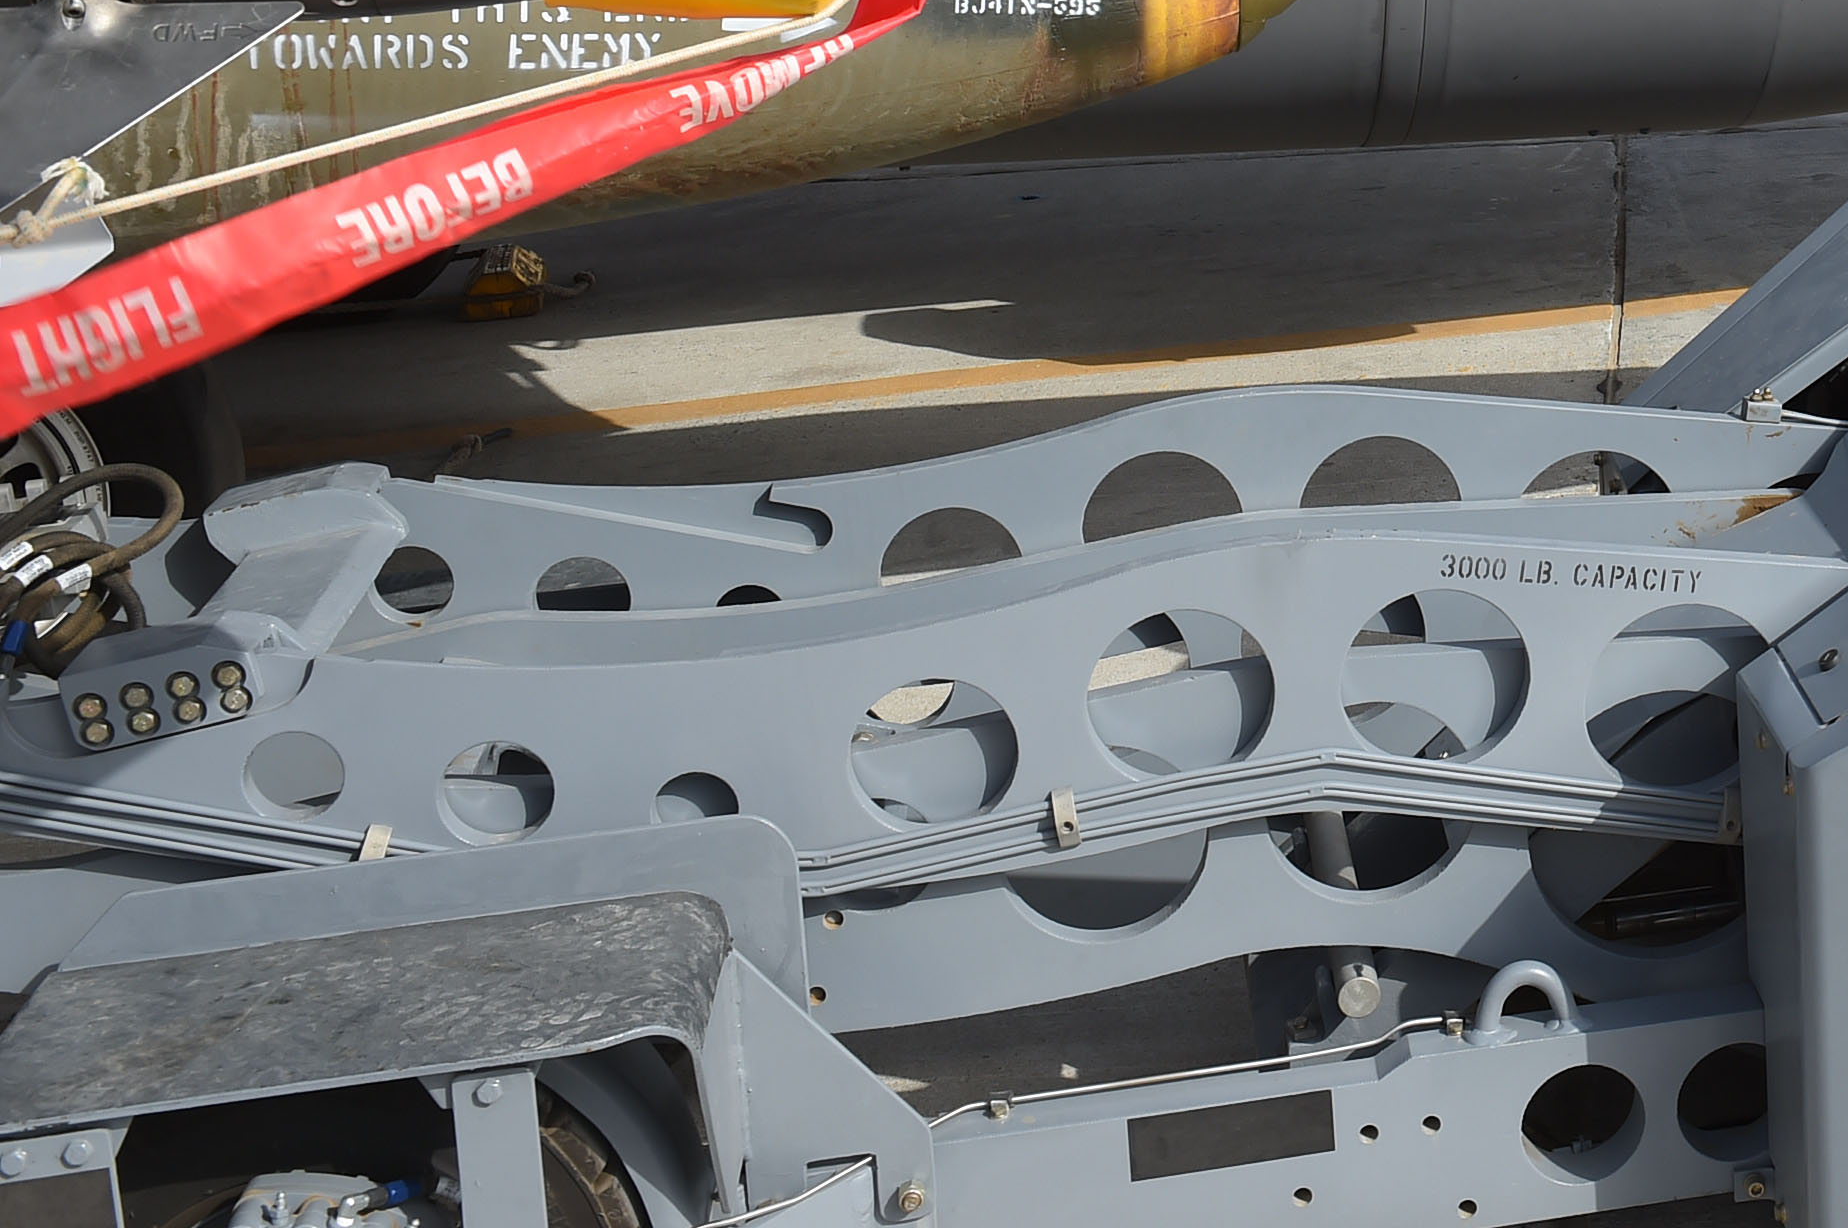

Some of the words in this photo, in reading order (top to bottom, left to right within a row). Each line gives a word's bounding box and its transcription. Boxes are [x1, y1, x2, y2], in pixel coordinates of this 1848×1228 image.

[152, 23, 218, 43] FWD
[508, 32, 661, 70] ENEMY
[335, 147, 534, 269] BEFORE
[12, 275, 205, 398] FLIGHT
[1440, 554, 1507, 583] 3000
[1519, 559, 1558, 585] LB.
[1573, 562, 1703, 594] CAPACITY
